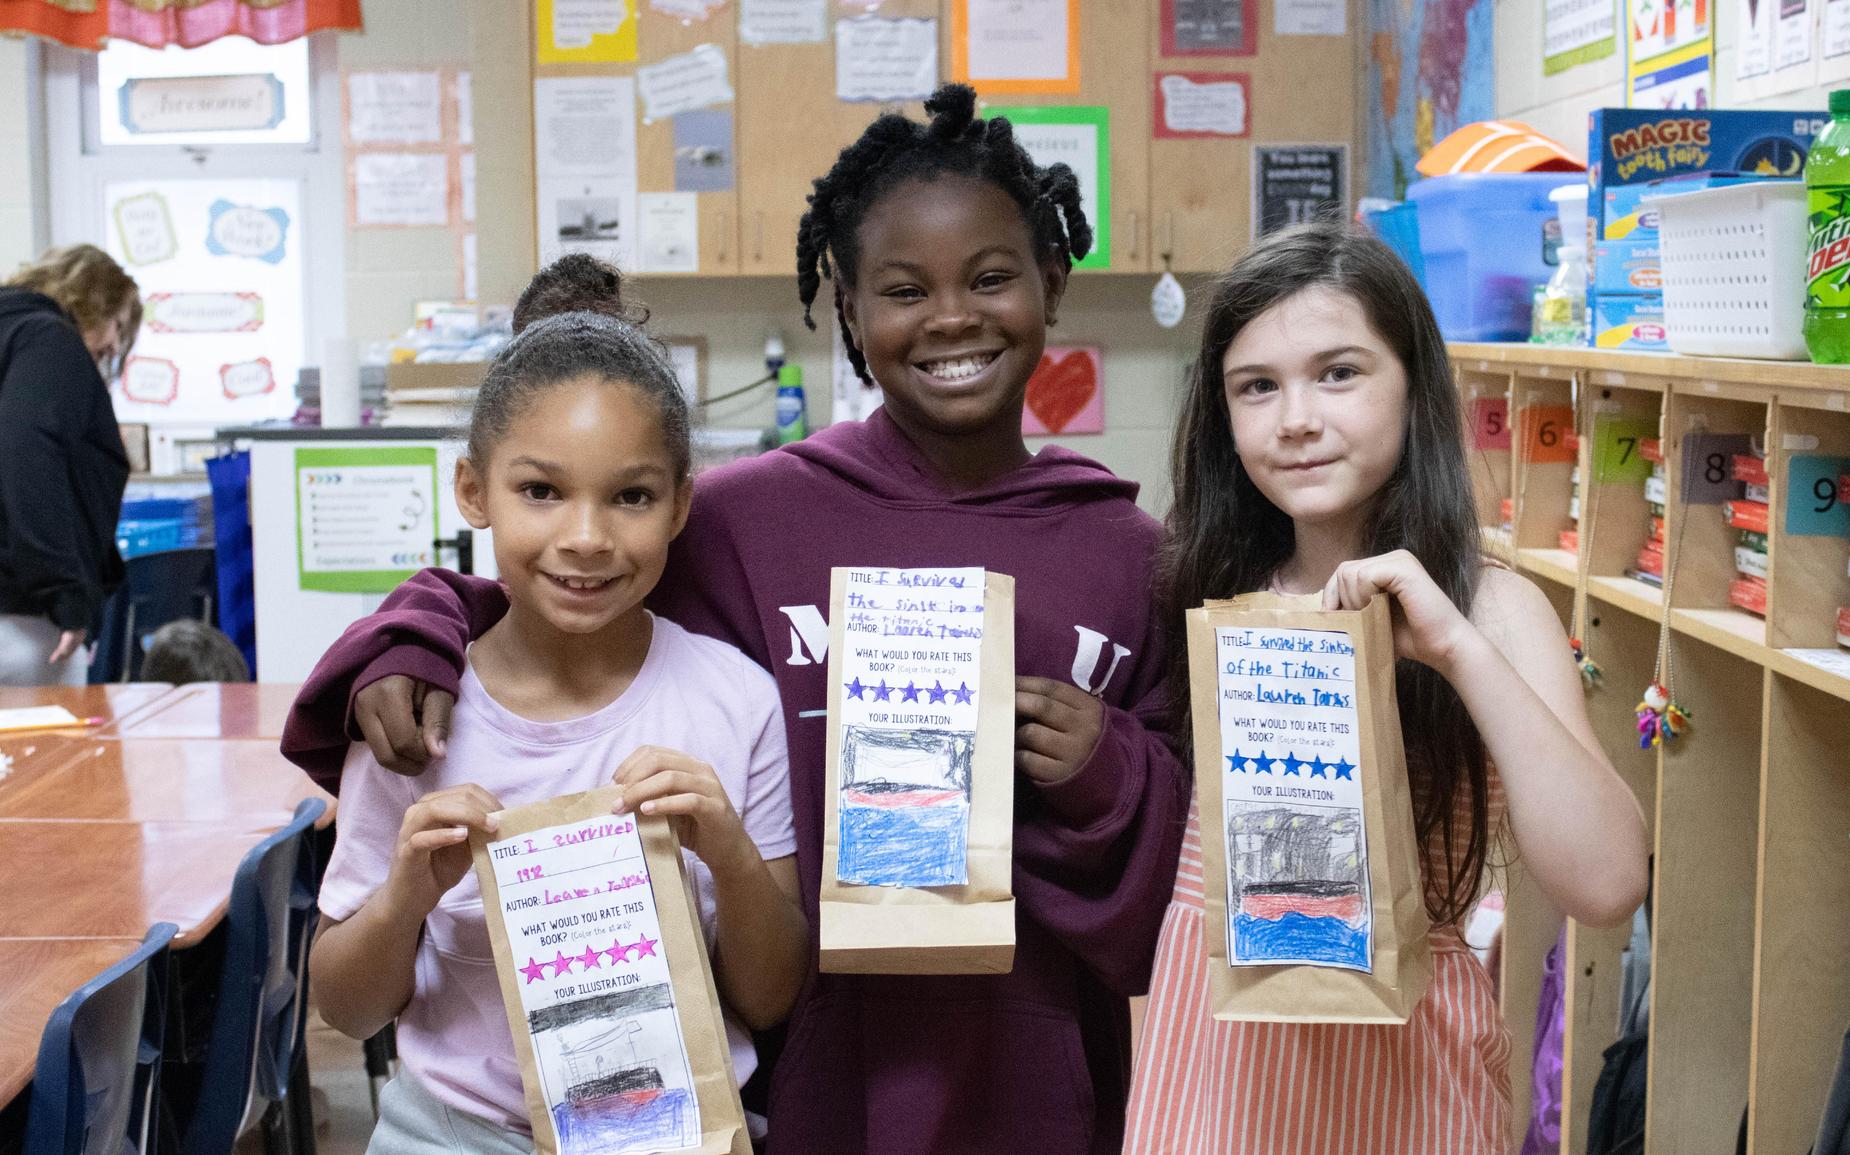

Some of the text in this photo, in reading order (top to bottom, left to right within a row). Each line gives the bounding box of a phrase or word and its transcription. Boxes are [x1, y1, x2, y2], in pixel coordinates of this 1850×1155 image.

[1610, 118, 1712, 160] MAGIC
[1617, 144, 1712, 181] tooth fairy
[1487, 411, 1501, 436] 5
[1539, 420, 1557, 447] 6
[1617, 437, 1636, 466] 7
[1705, 453, 1726, 484] 8
[1813, 477, 1837, 513] 9
[850, 572, 873, 584] TITLE:
[874, 571, 890, 586] I
[848, 592, 883, 610] the
[847, 623, 879, 634] AUTHOR:
[1222, 635, 1244, 647] TITLE:
[1244, 631, 1254, 646] I
[855, 648, 973, 662] WHAT WOULD YOU RATE THIS
[869, 662, 896, 673] BOOK?
[1249, 660, 1272, 676] the
[1282, 660, 1341, 679] Titanic
[1224, 689, 1256, 701] AUTHOR:
[868, 713, 953, 725] YOUR ILLUSTRATION:
[1234, 717, 1350, 734] WHAT WOULD YOU RATE THIS
[1248, 732, 1274, 743] BOOK?
[1252, 785, 1336, 801] YOUR ILLUSTRATION:
[493, 844, 521, 860] TITLE:
[523, 839, 539, 854] I
[506, 896, 542, 912] AUTHOR:
[521, 901, 645, 937] WHAT WOULD YOU RATE THIS
[540, 932, 568, 947] BOOK?
[553, 972, 643, 1000] YOUR ILLUSTRATION:
